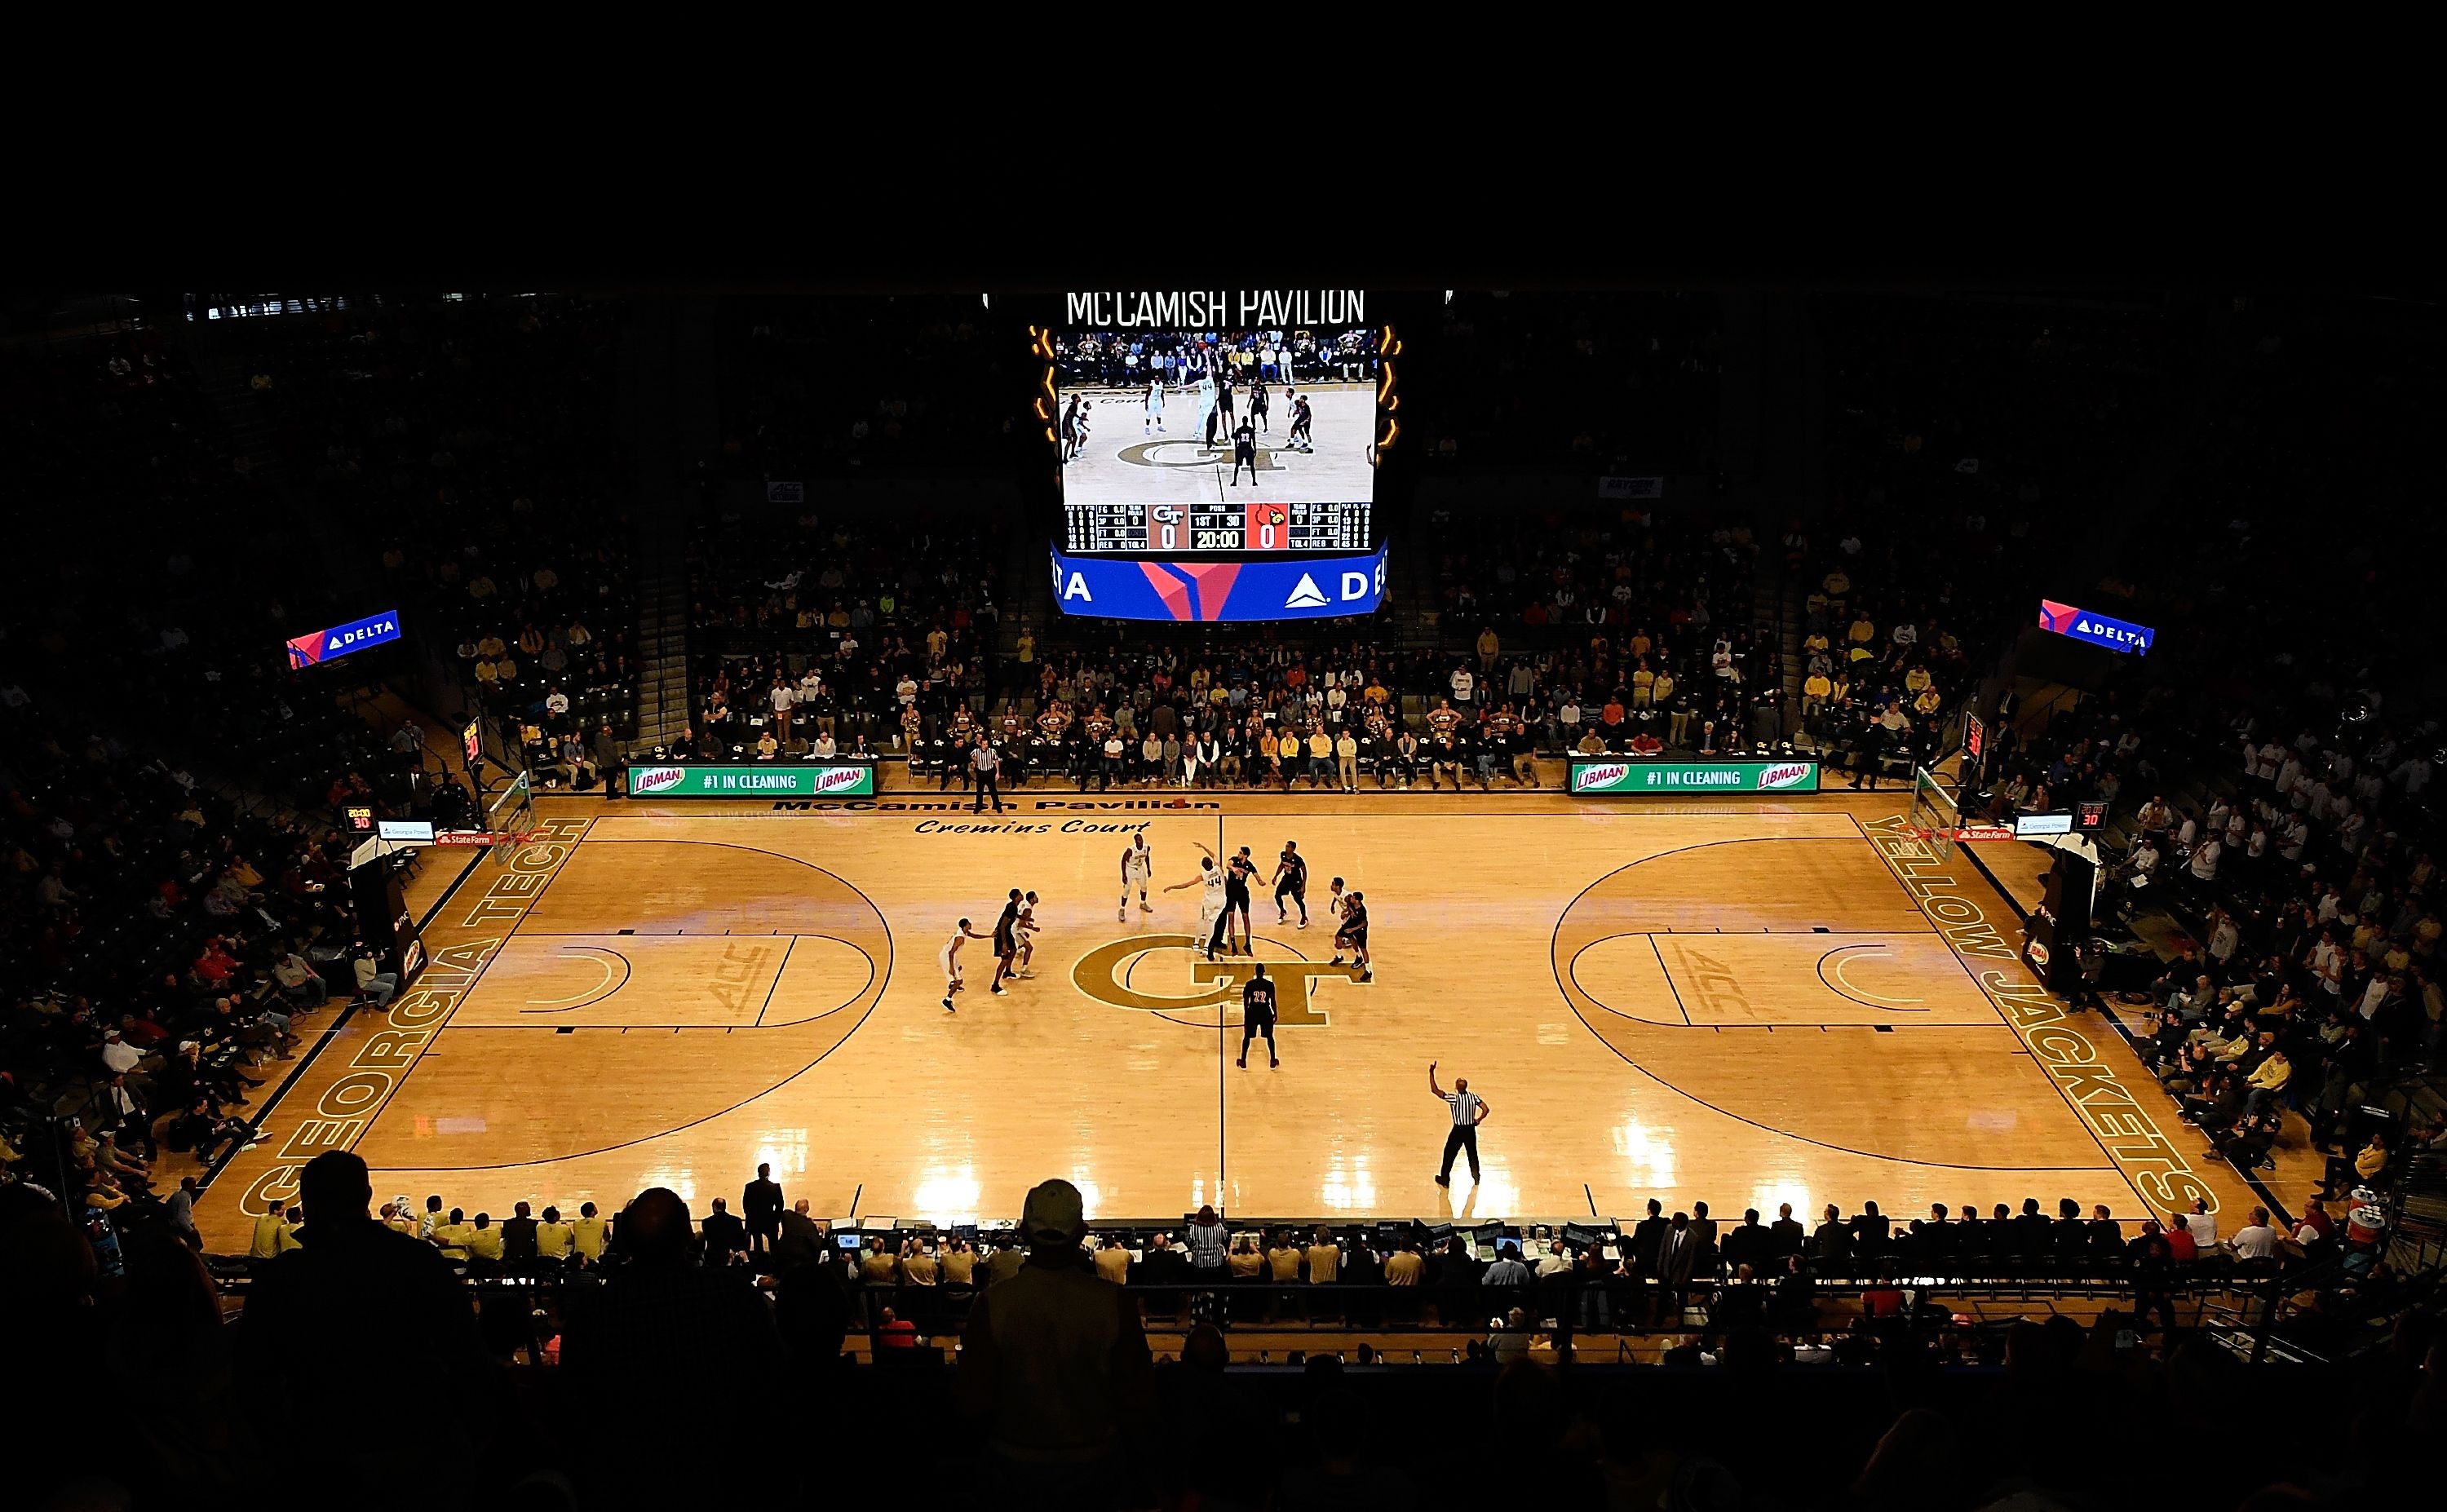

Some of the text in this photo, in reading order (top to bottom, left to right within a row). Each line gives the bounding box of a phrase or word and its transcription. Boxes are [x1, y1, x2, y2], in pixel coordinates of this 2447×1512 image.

[1241, 290, 1364, 325] PAVILION
[1133, 516, 1138, 525] 0
[1152, 505, 1184, 524] GT
[1195, 515, 1239, 526] 1ST 30
[1297, 515, 1303, 524] 0
[1161, 524, 1176, 549] 0
[1197, 531, 1239, 548] 20:00
[1260, 524, 1274, 549] 0
[1051, 551, 1092, 602] LTA
[344, 621, 394, 644] DELTA
[2093, 623, 2145, 647] DELTA
[467, 736, 478, 760] 30
[635, 769, 682, 790] LIBMAN
[704, 775, 796, 789] #1 IN CLEANING
[816, 769, 861, 790] LIBMAN
[1577, 766, 1625, 788] LIBMAN
[1647, 771, 1740, 785] #1 IN CLEANING
[1758, 765, 1805, 788] LIBMAN
[1035, 800, 1220, 809] Pavilion
[354, 818, 369, 828] 30
[915, 819, 1150, 833] Cremins Court
[2083, 815, 2098, 825] 30
[1208, 875, 1221, 887] 44
[399, 911, 410, 926] PNC
[1253, 991, 1267, 1004] 22
[240, 818, 590, 1216] GEORGIA TECH
[1863, 814, 2220, 1216] YELLOW JACKETS
